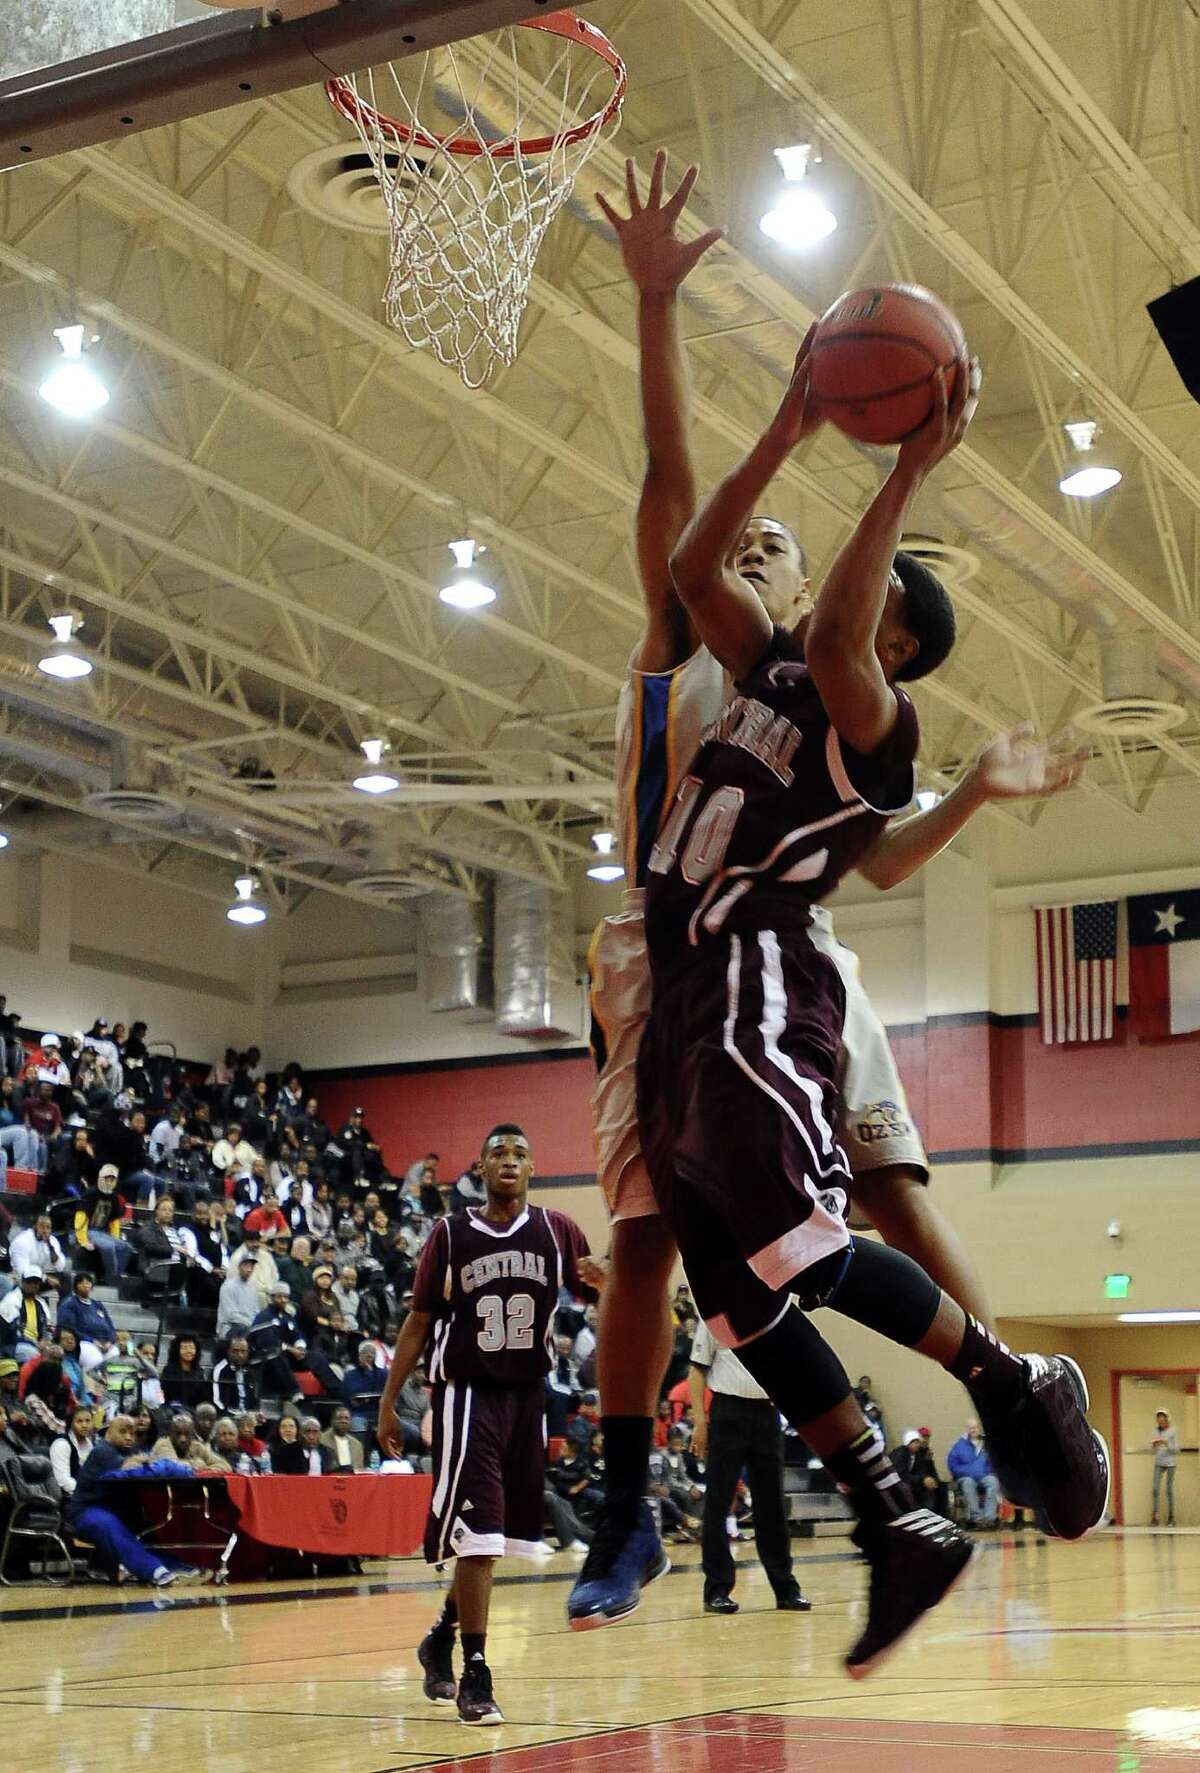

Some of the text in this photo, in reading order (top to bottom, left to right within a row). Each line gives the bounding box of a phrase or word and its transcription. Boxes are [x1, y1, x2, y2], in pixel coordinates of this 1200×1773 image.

[647, 775, 744, 885] 10
[461, 1250, 548, 1294] CENTRAL
[476, 1294, 535, 1352] 32
